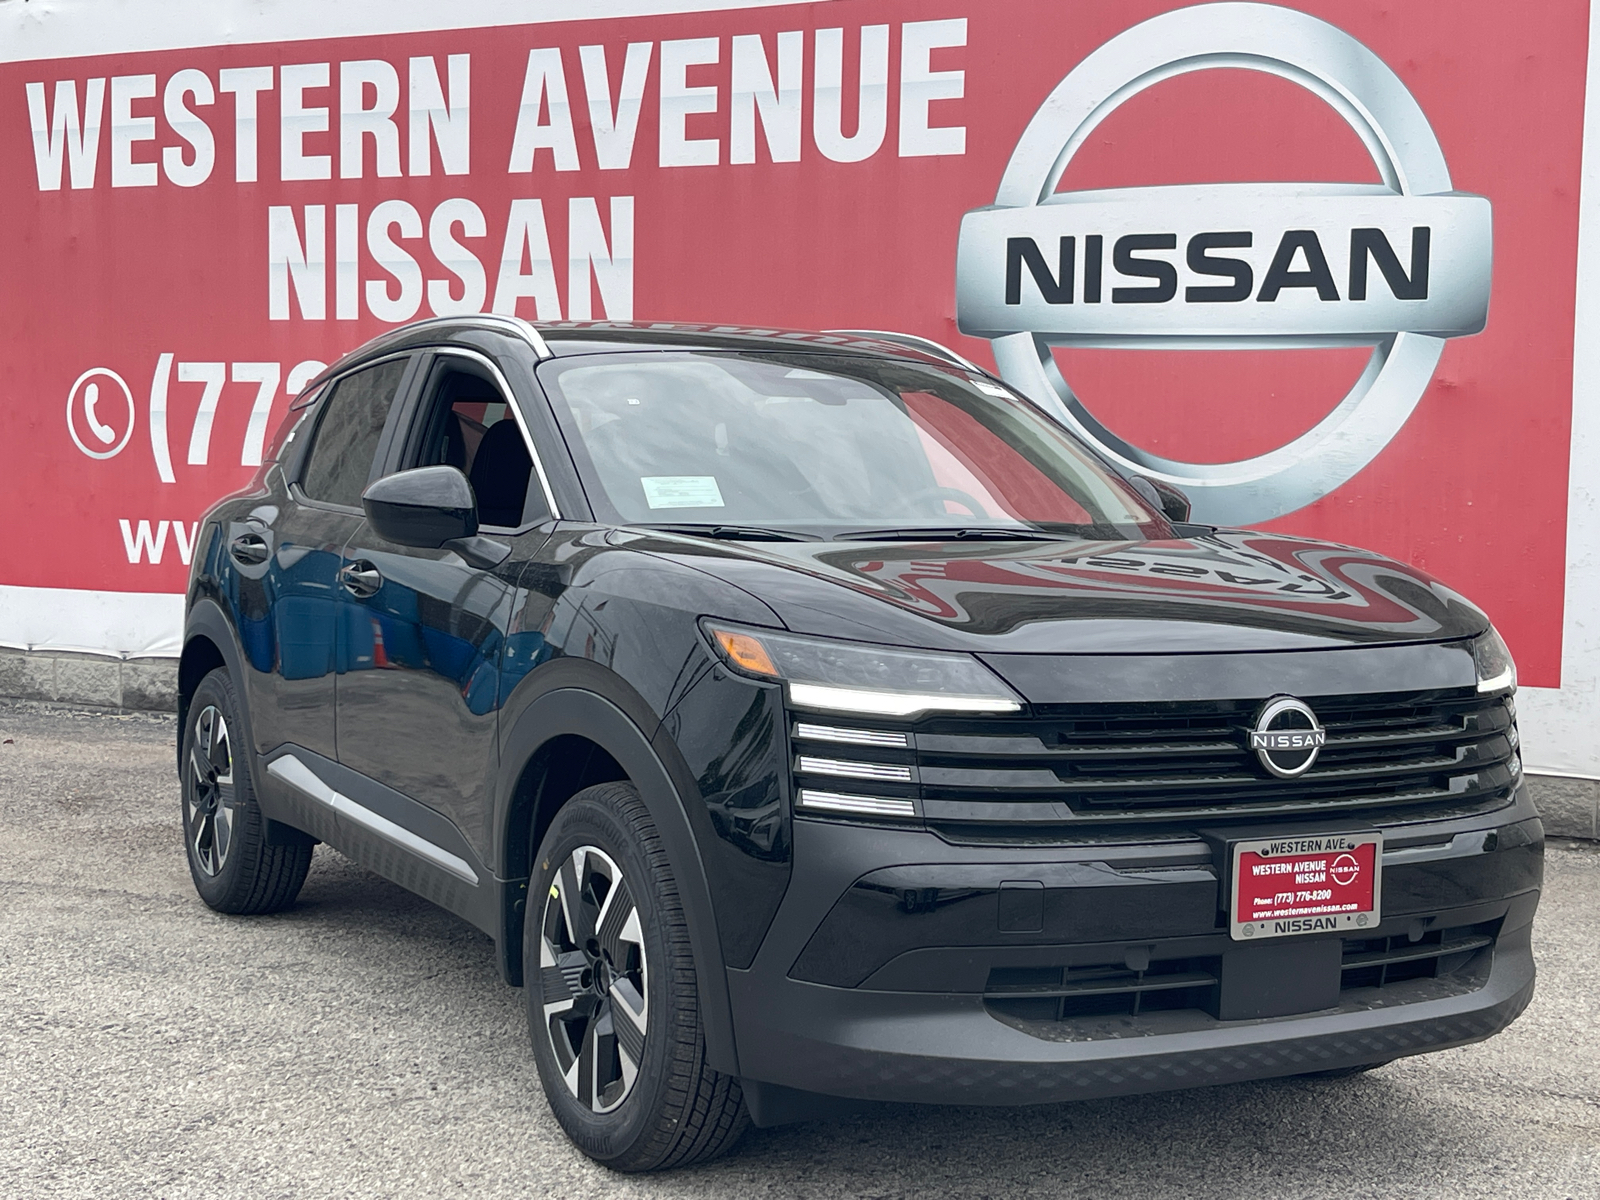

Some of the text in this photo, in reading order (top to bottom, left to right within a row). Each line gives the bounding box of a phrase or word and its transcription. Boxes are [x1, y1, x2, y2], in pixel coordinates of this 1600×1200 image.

[26, 18, 968, 191] WESTERN AVENUE
[268, 196, 634, 322] NISSAN
[1005, 226, 1431, 305] NISSAN
[1253, 733, 1325, 748] NISSAN
[1271, 840, 1322, 854] WESTERN
[1252, 860, 1327, 876] WESTERN AVENUE
[1295, 872, 1326, 885] NISSAN
[1253, 889, 1331, 906] Phone: (773) 776-8200
[1252, 903, 1358, 919] www.westernavenissan.com
[1275, 916, 1337, 933] NISSAN
